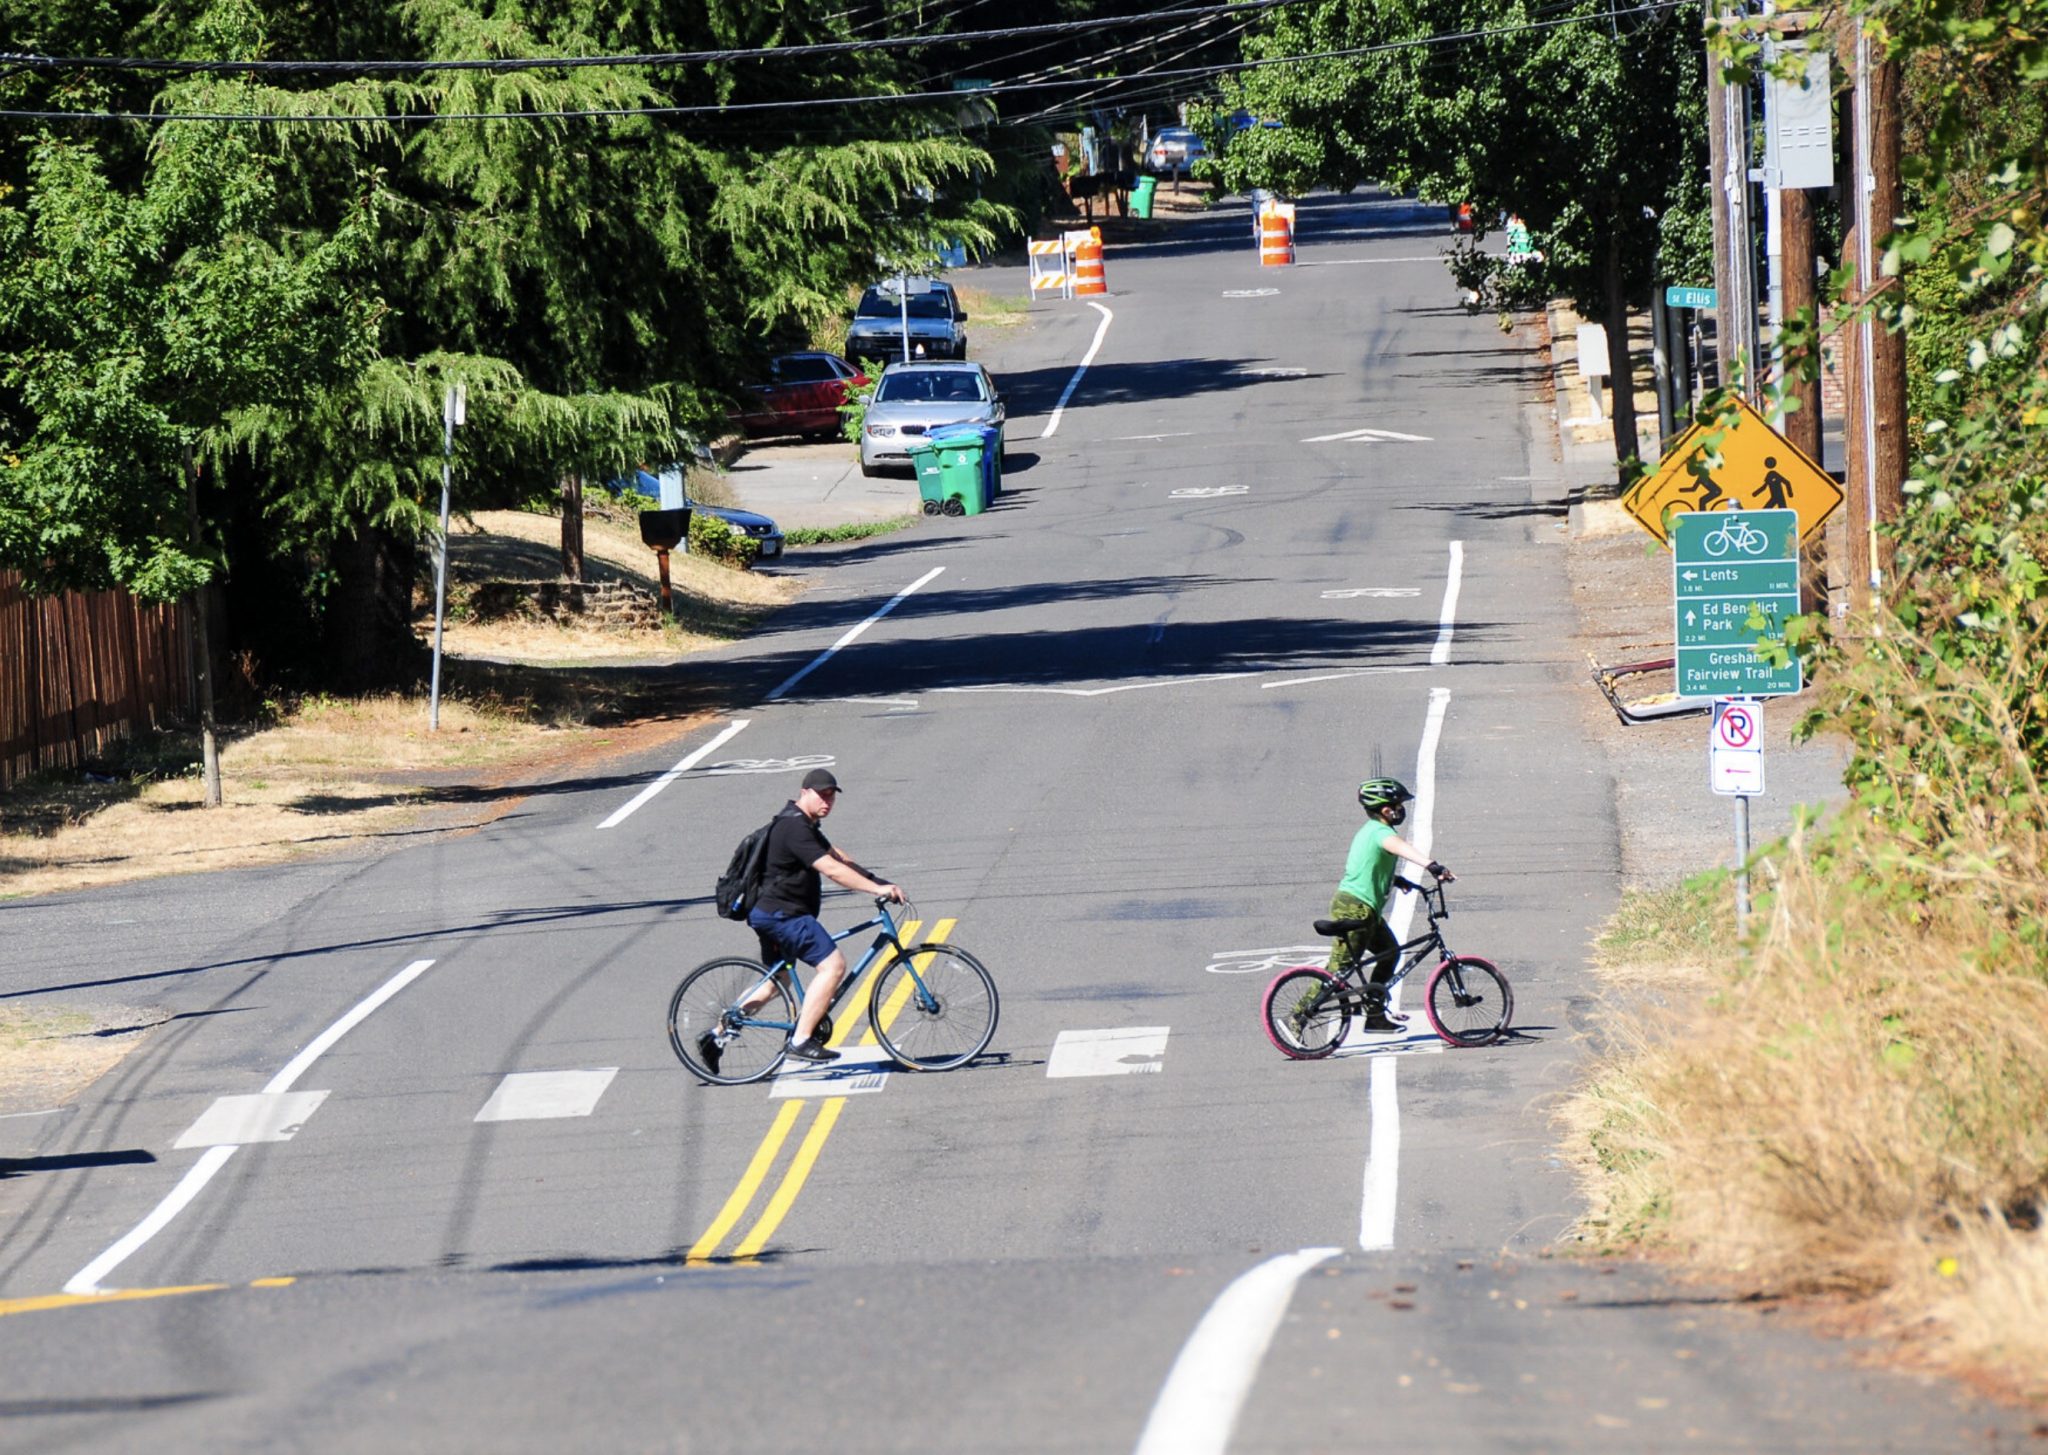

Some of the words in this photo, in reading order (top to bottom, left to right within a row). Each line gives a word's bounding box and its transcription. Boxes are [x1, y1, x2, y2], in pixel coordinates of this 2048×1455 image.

[1686, 292, 1711, 304] Ellis
[1703, 569, 1738, 581] Lents
[1703, 604, 1718, 615] Ed
[1723, 602, 1778, 614] Benict
[1704, 619, 1732, 630] Park
[1688, 668, 1740, 680] Fairview
[1746, 666, 1772, 679] Trail
[1730, 716, 1746, 738] P
